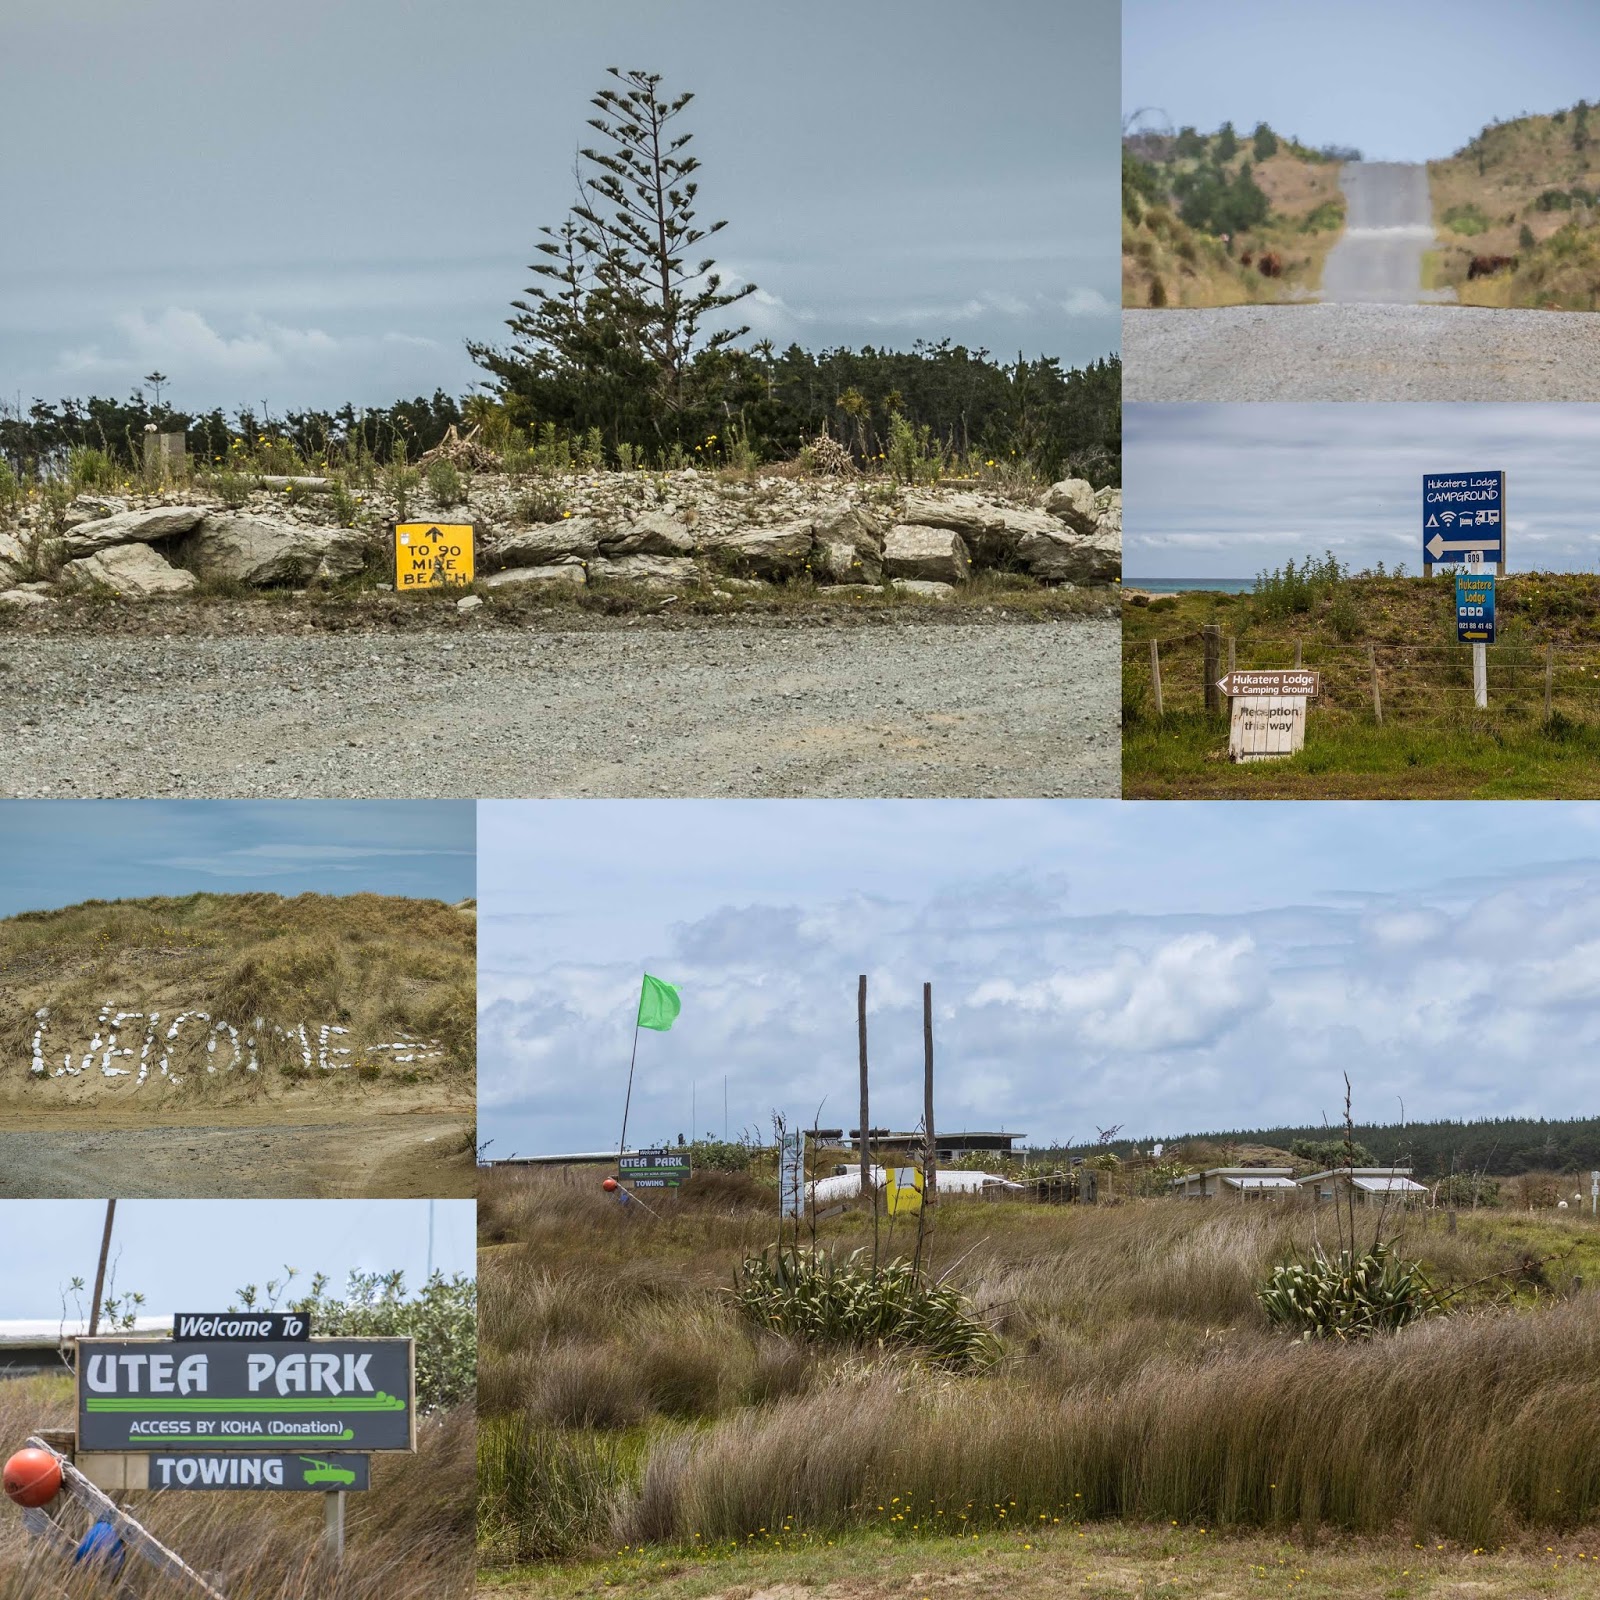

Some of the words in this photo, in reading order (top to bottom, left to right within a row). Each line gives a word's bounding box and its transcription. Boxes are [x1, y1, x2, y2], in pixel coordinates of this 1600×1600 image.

[1427, 479, 1467, 489] Hukatere
[1470, 477, 1498, 491] Lodge
[1427, 490, 1498, 502] CAMPGROUND
[408, 545, 430, 556] TO
[438, 546, 461, 557] 90
[1467, 553, 1480, 563] 809
[412, 559, 457, 570] MIE
[1458, 578, 1492, 590] Hukatere
[1464, 591, 1486, 604] Lodge
[1232, 675, 1280, 684] Hukatere
[1283, 674, 1315, 686] Lodge
[1232, 685, 1240, 693] &
[1242, 685, 1279, 695] Camping
[1282, 685, 1313, 694] Ground
[1269, 723, 1292, 732] way
[620, 1158, 647, 1168] UTEA
[655, 1157, 682, 1167] PARK
[179, 1316, 272, 1337] Welcome
[282, 1316, 303, 1337] To
[86, 1353, 209, 1396] UTEA
[247, 1353, 375, 1396] PARK
[130, 1420, 191, 1434] ACCESS
[196, 1420, 217, 1434] BY
[221, 1420, 263, 1434] KOHA
[268, 1420, 344, 1436] (Donation)
[157, 1458, 284, 1485] TOWING
